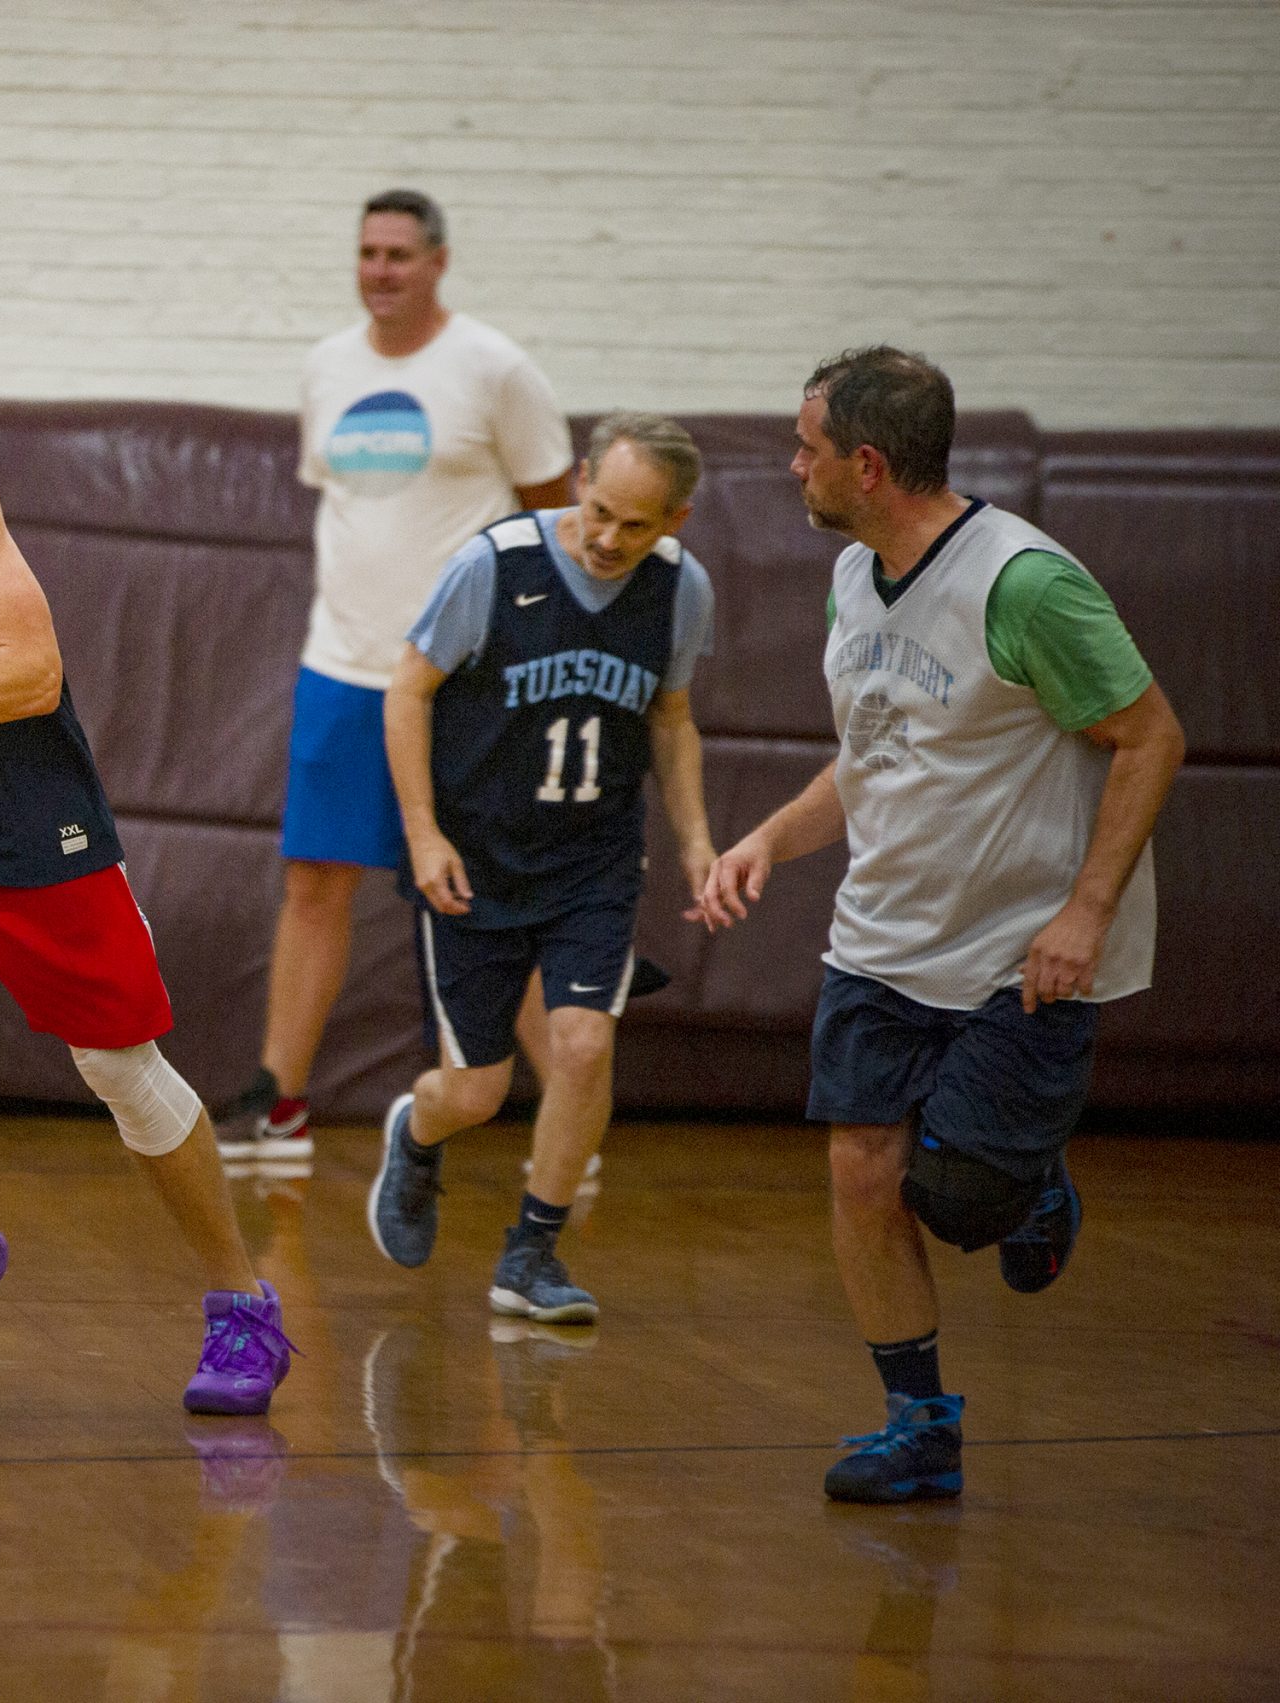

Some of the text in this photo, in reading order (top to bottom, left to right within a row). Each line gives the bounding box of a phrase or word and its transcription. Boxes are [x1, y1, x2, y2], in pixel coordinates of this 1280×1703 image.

[503, 649, 659, 716] TUESDAY
[537, 717, 601, 802] 11
[59, 824, 85, 838] XXL
